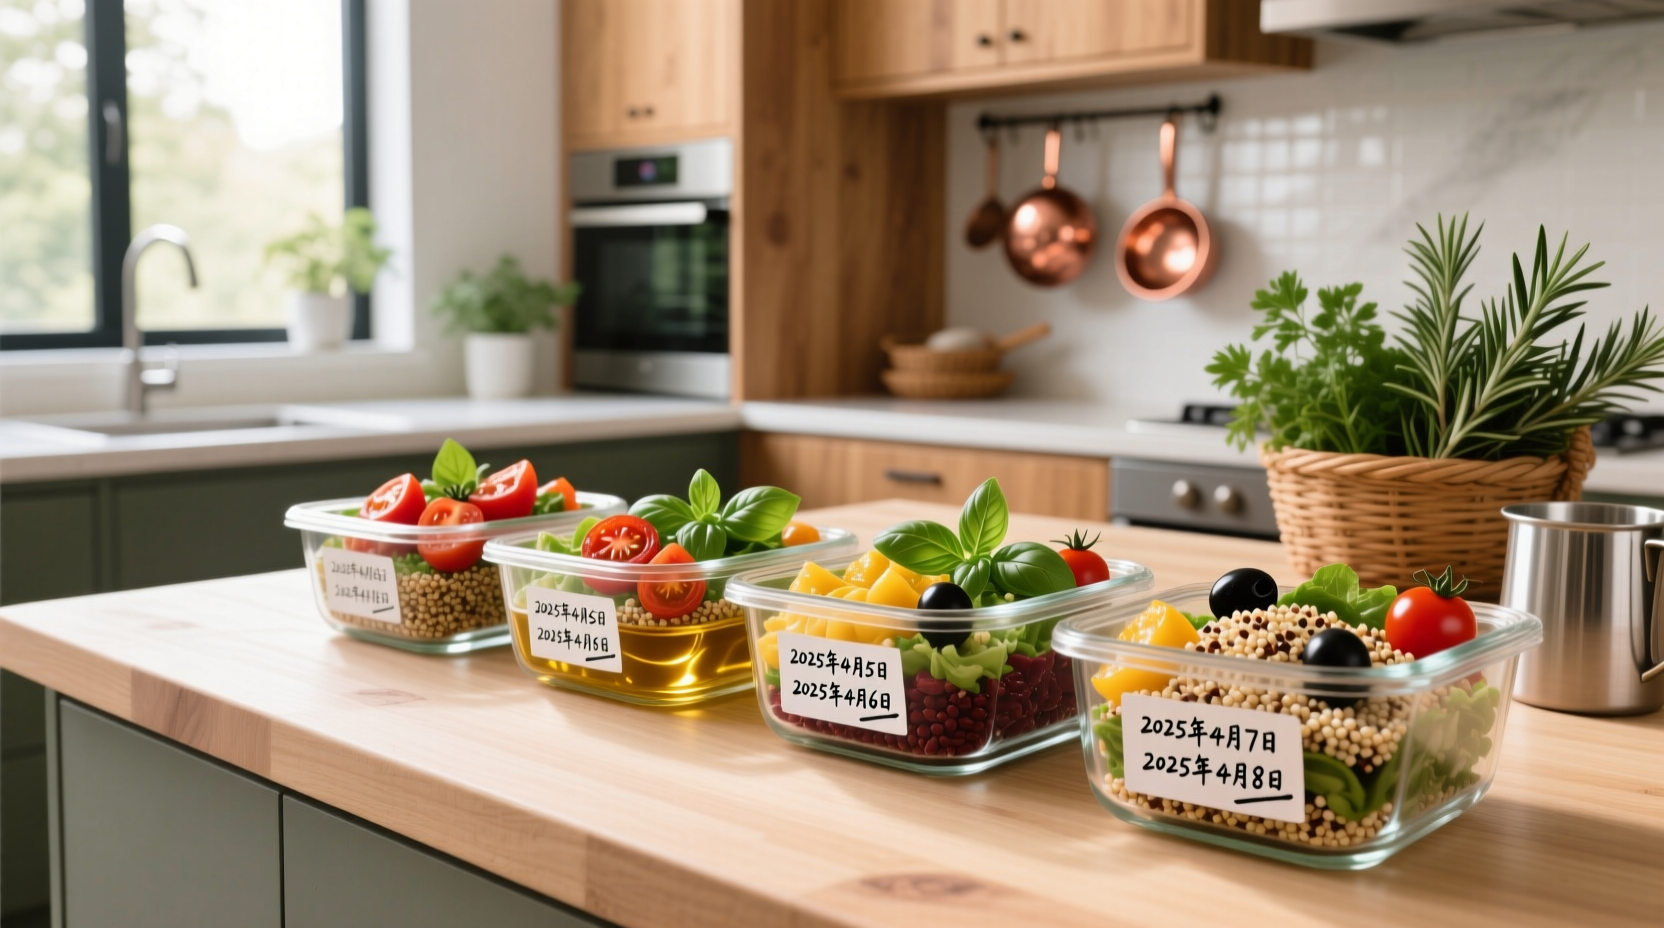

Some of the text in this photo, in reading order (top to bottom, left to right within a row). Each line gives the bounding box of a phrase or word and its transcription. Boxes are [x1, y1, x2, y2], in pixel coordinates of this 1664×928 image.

[790, 648, 887, 680] 2025年4月5日
[792, 680, 891, 711] 2025年4月6日
[1140, 716, 1276, 753] 2025年4月7日
[1142, 752, 1282, 791] 2025年4月8日
